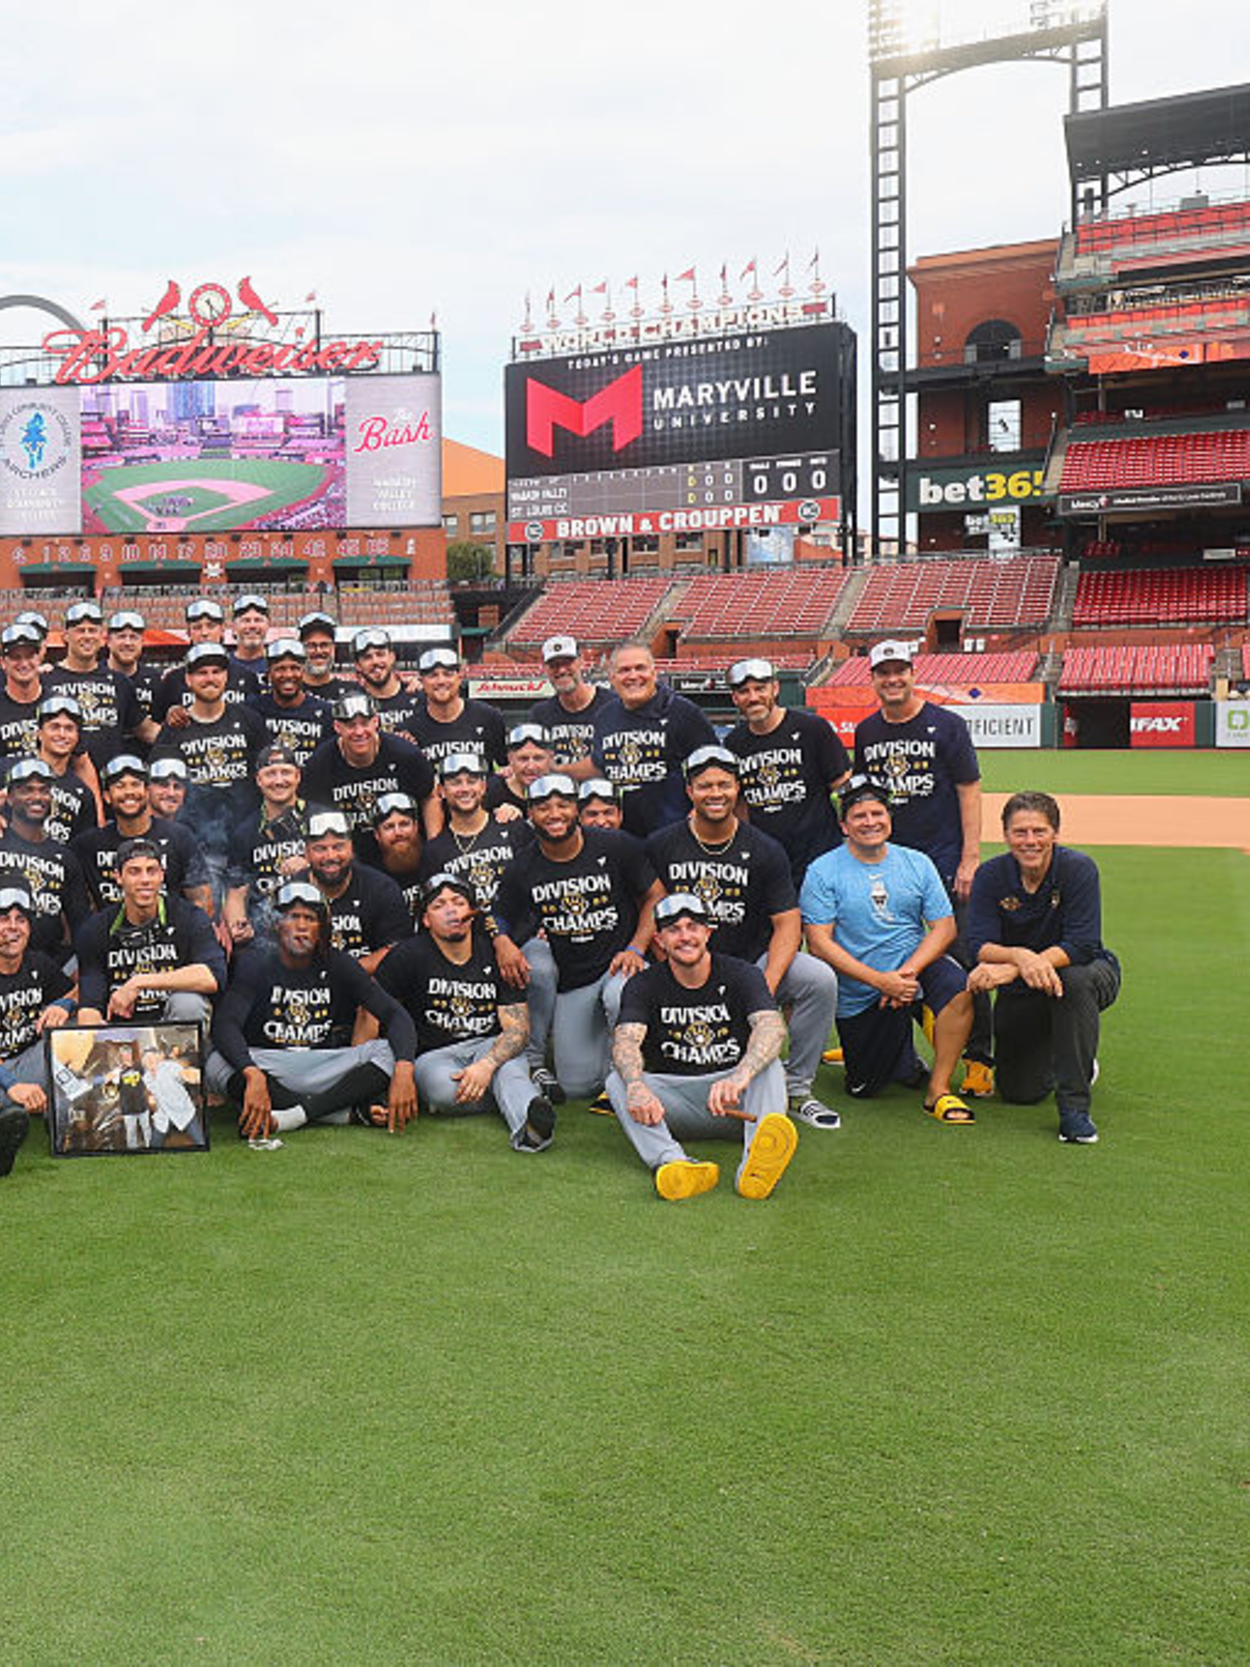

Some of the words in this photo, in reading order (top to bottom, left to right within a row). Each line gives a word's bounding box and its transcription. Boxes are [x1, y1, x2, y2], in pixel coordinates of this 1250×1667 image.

[640, 302, 801, 338] CHAMPIONS
[42, 329, 384, 384] Budweiser
[624, 348, 661, 365] GAME
[665, 340, 741, 359] PRESENTED
[653, 371, 817, 412] MARYVILLE
[653, 402, 816, 430] UNIVERSITY
[353, 409, 435, 453] Bash
[705, 475, 714, 486] 0
[724, 473, 733, 484] 0
[753, 475, 768, 494] 0
[782, 472, 797, 492] 0
[811, 470, 827, 489] 0
[705, 491, 714, 502] 0
[724, 490, 733, 501] 0
[556, 515, 634, 538] BROWN
[639, 518, 653, 532] &
[658, 504, 779, 531] CROUPPEN
[122, 544, 140, 560] 10
[0, 718, 41, 741] DIVIS
[550, 724, 595, 740] DIVISIO
[602, 731, 666, 750] DIVISION
[180, 734, 248, 756] DIVISION
[864, 739, 935, 762] DIVISION
[737, 748, 802, 775] DIVISION
[333, 777, 399, 802] DIVISION
[253, 842, 307, 862] DIVISIO
[668, 861, 748, 886] DIVISION
[531, 874, 611, 903] DIVISION
[543, 905, 619, 932] CHAMPS
[108, 943, 178, 968] DIVISION
[661, 1036, 741, 1065] CHAMPS
